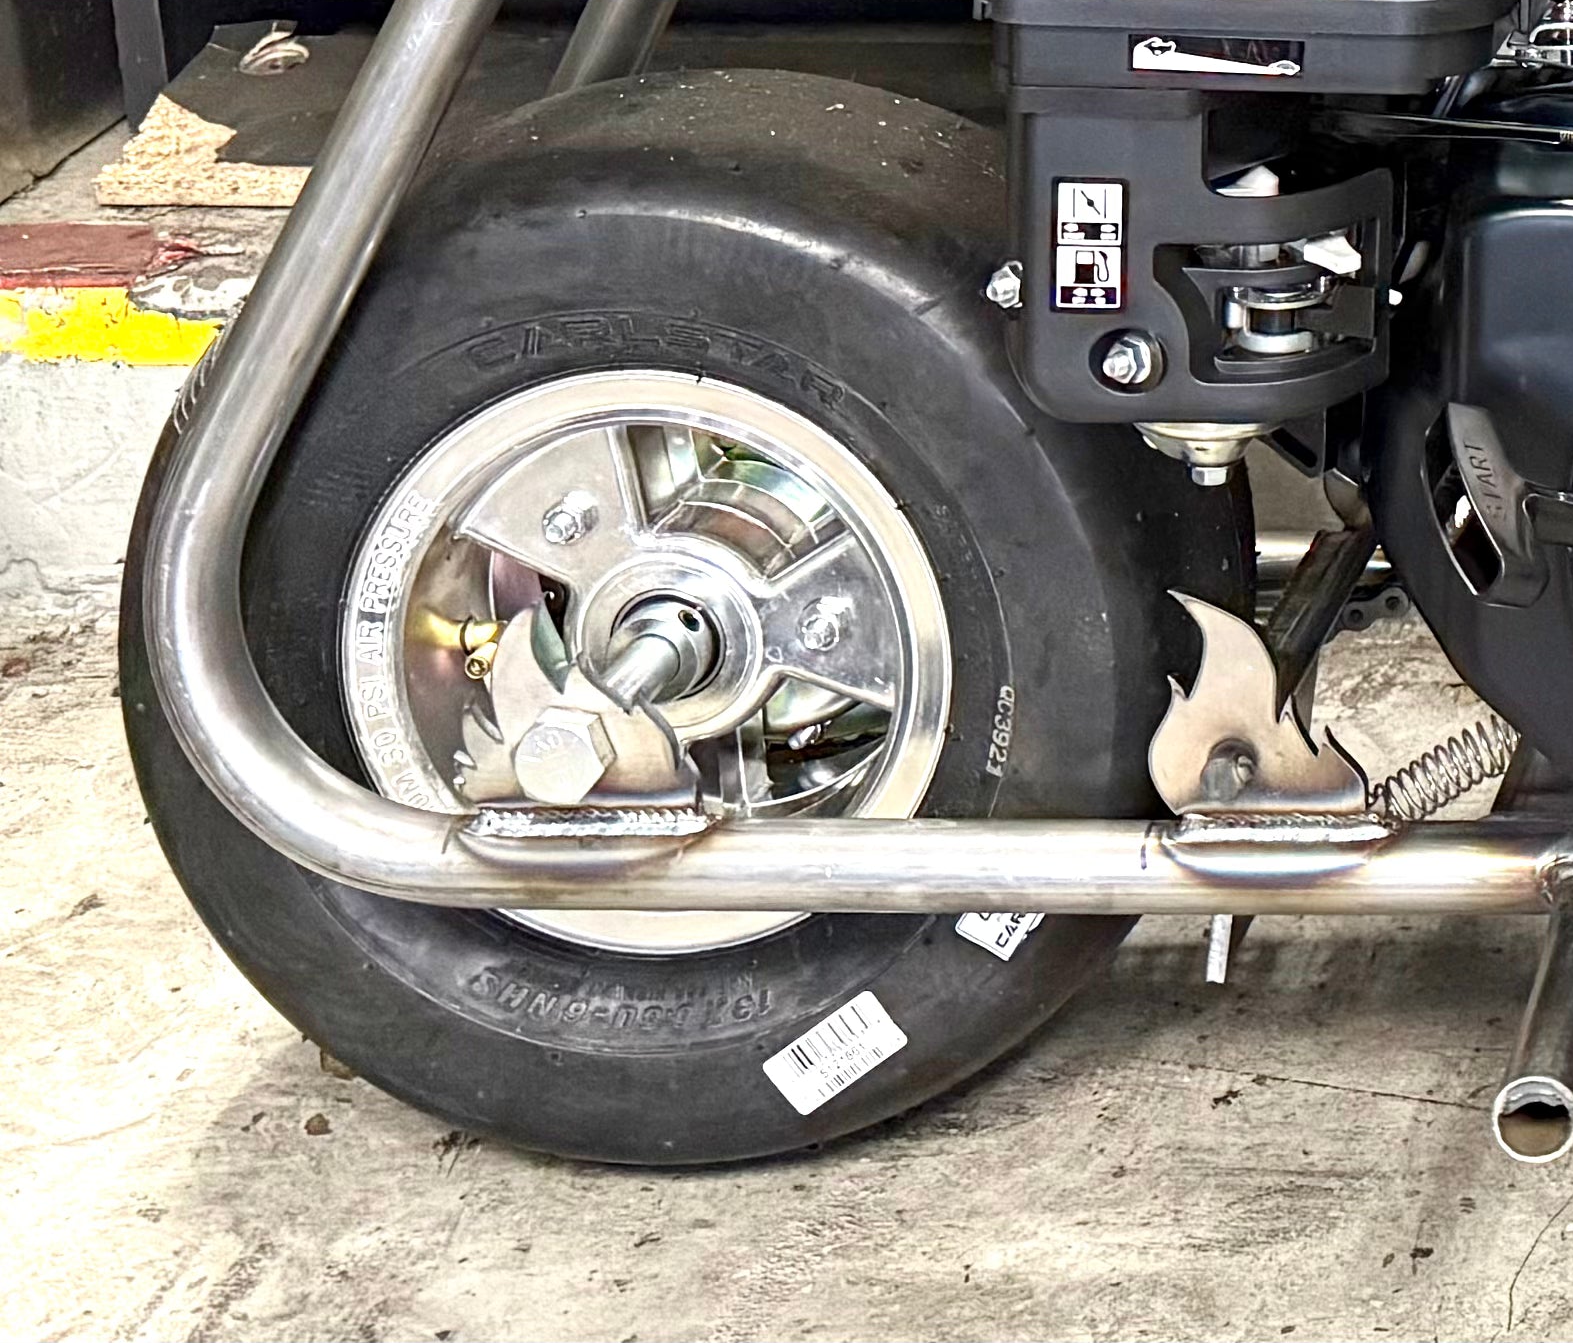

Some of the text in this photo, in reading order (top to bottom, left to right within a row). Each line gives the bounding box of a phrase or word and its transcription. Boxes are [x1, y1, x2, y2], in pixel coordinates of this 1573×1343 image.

[355, 489, 438, 721] PSI AIR PRESSURE
